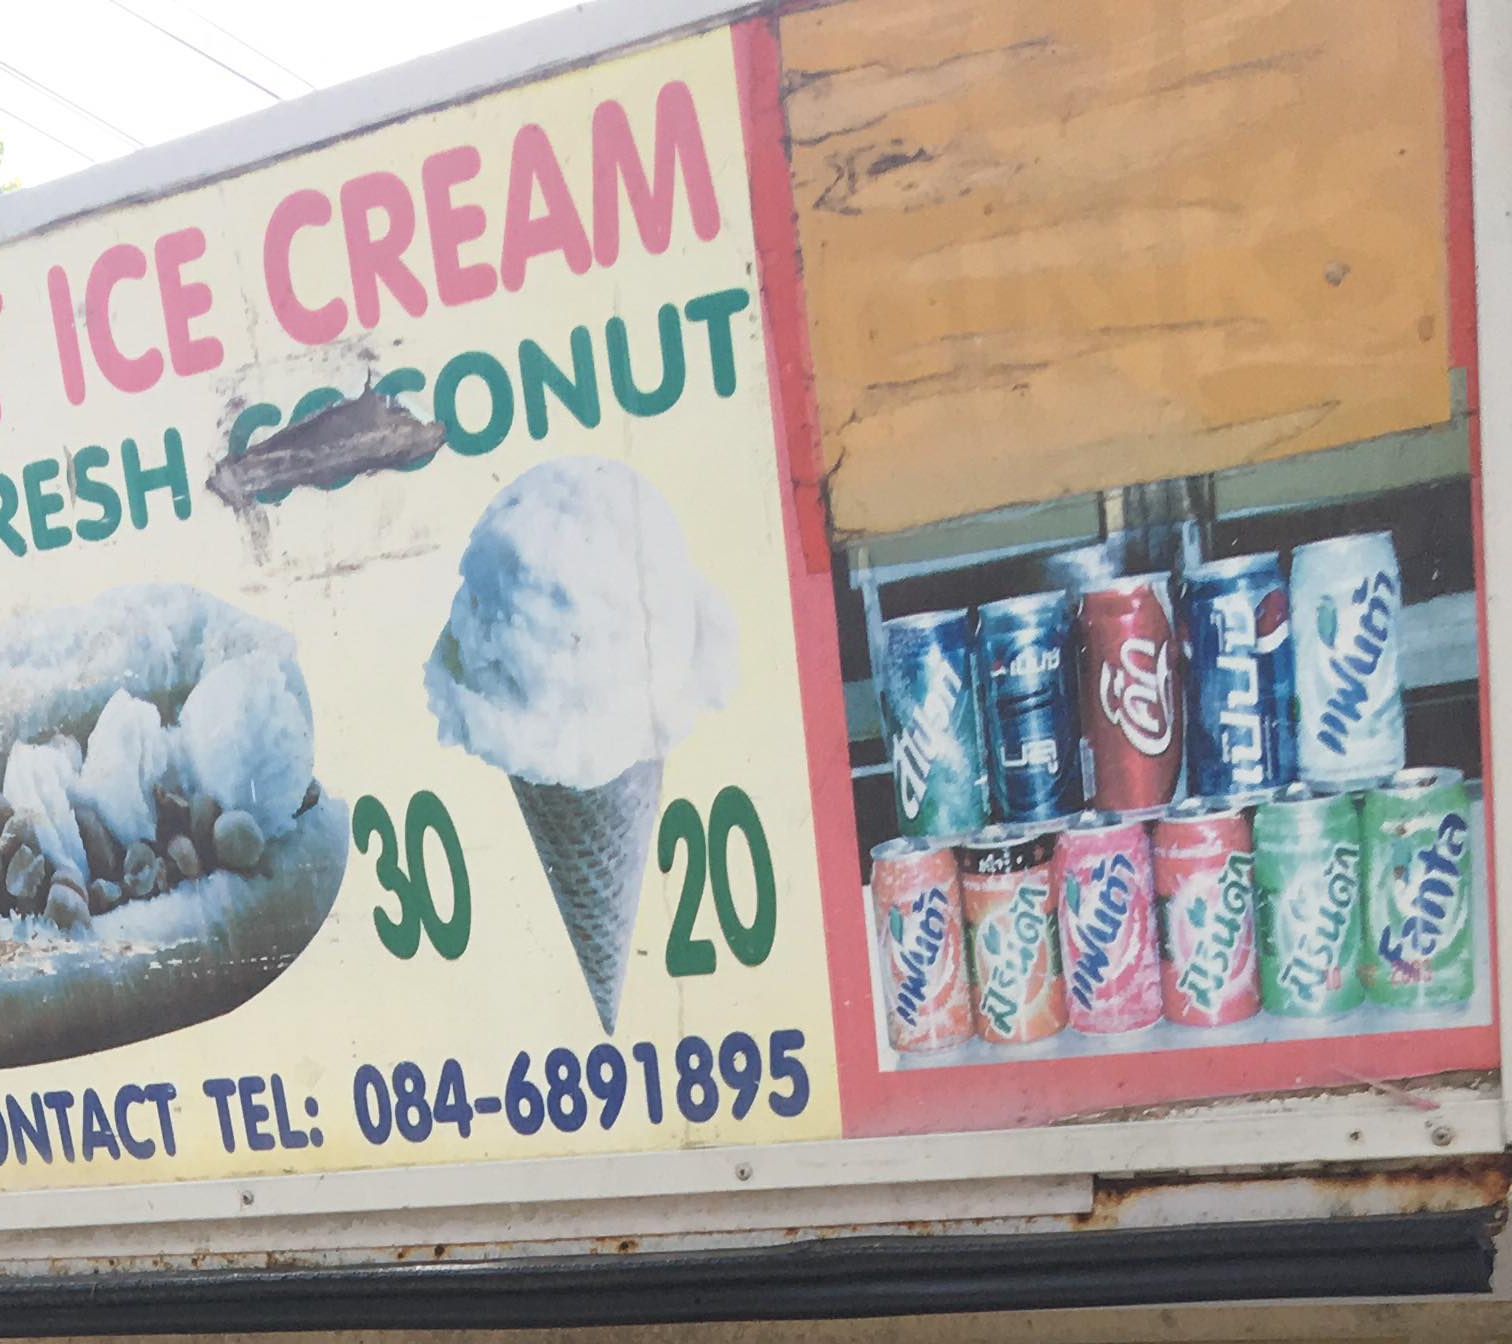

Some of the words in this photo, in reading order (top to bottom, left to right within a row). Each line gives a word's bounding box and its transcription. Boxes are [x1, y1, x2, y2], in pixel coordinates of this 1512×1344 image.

[48, 226, 224, 406] ICE
[262, 80, 722, 346] CREAM
[352, 790, 472, 960] 30
[658, 786, 777, 977] 20
[203, 1073, 324, 1154] TEL:
[353, 1029, 811, 1145] 084-6891895
